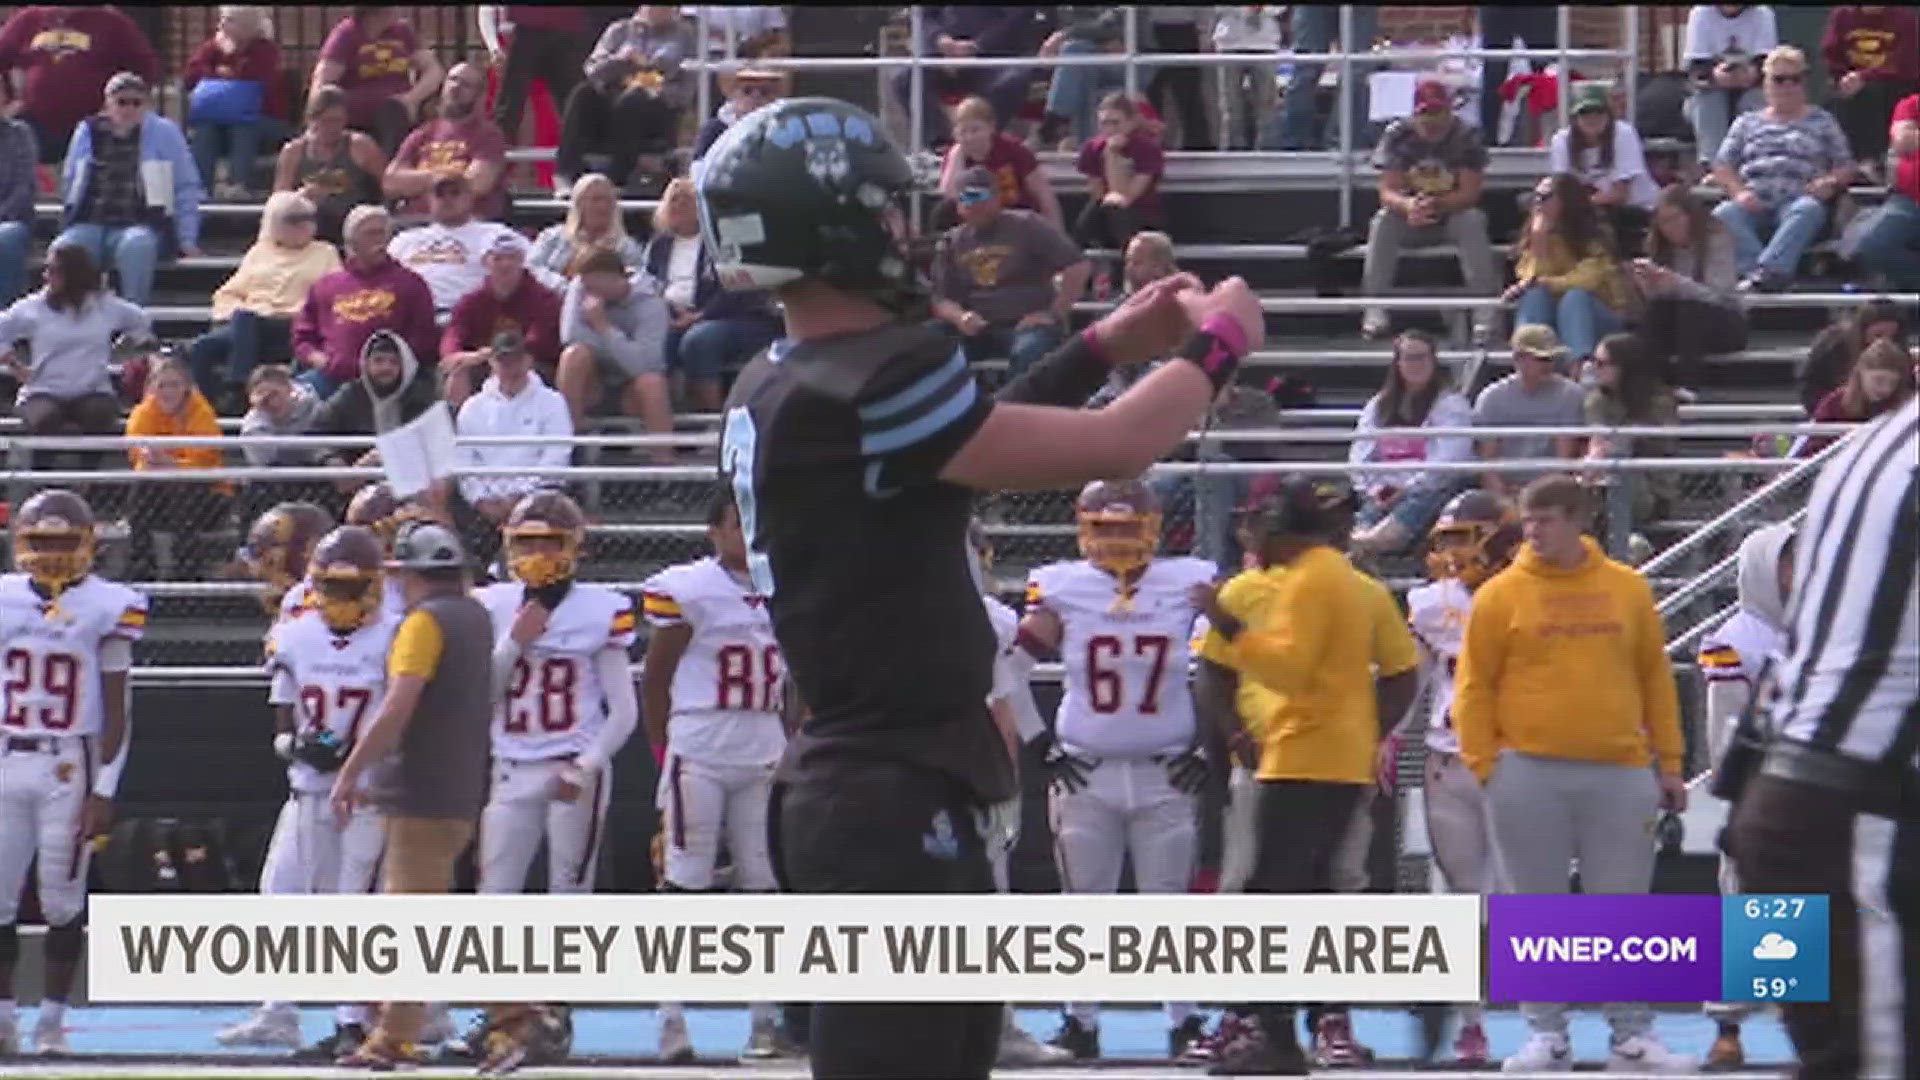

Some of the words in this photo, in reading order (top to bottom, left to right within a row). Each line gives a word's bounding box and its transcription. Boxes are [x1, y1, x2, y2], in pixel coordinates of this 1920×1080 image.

[4, 648, 78, 730] 29
[504, 656, 576, 733] 28
[1087, 635, 1168, 715] 67
